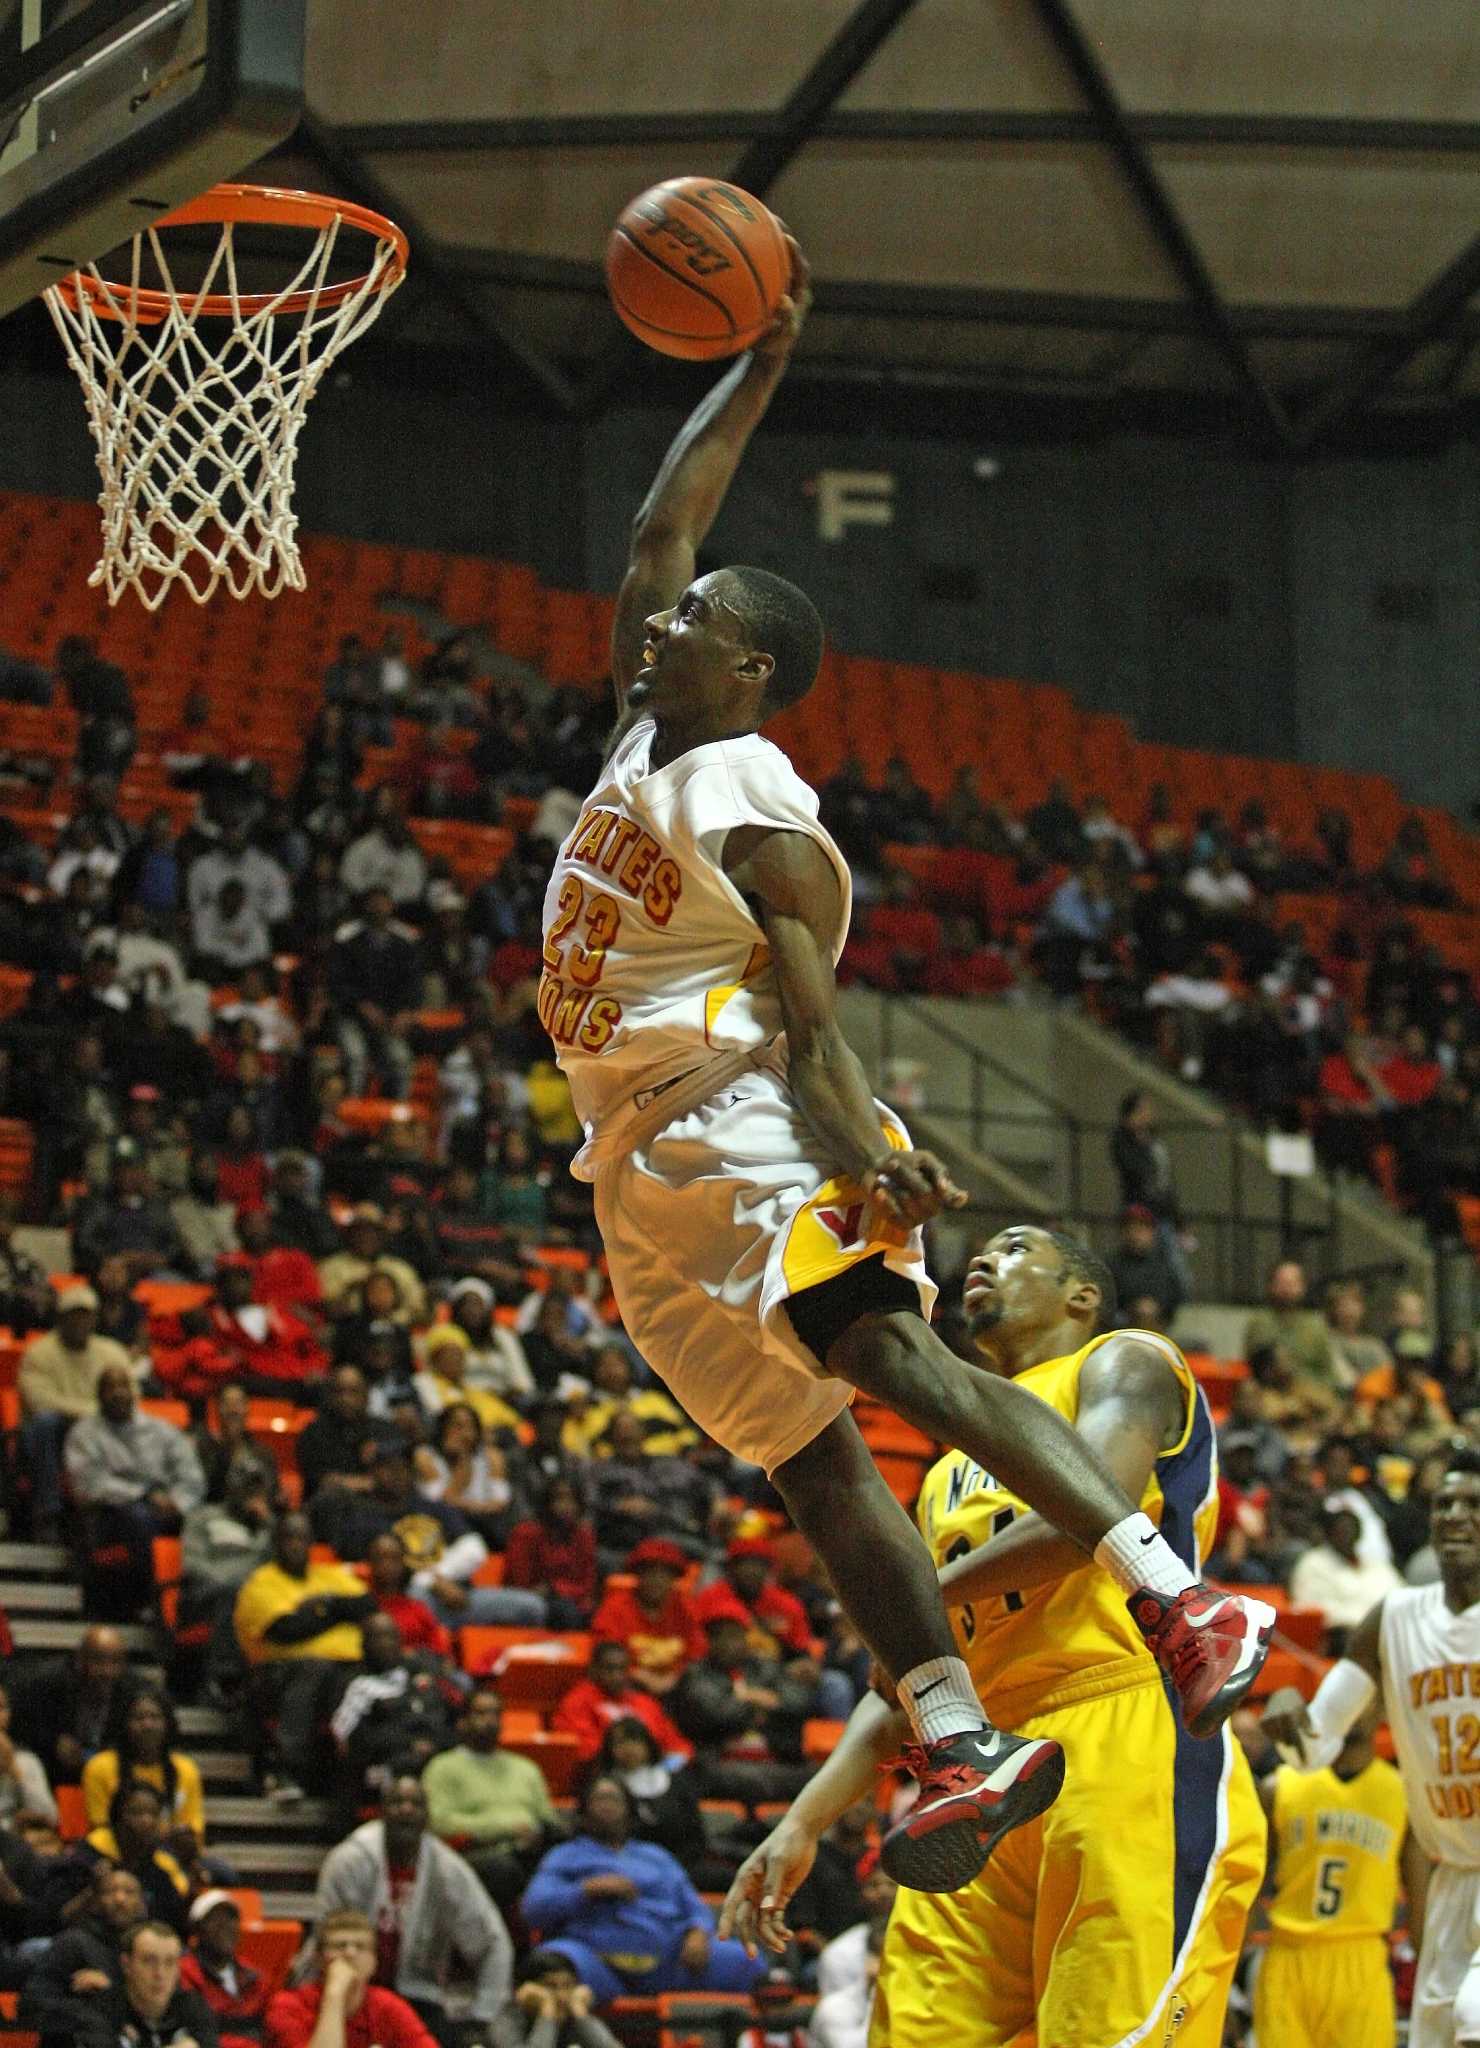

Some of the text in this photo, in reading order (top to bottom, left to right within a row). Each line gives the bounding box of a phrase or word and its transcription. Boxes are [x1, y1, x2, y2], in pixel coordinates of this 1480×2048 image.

[817, 469, 893, 540] F
[564, 808, 682, 926] YATES
[543, 875, 621, 988] 23
[539, 972, 623, 1055] ONS
[1409, 1662, 1480, 1710] YATE
[1431, 1712, 1480, 1777] 12
[1316, 1857, 1349, 1918] 5
